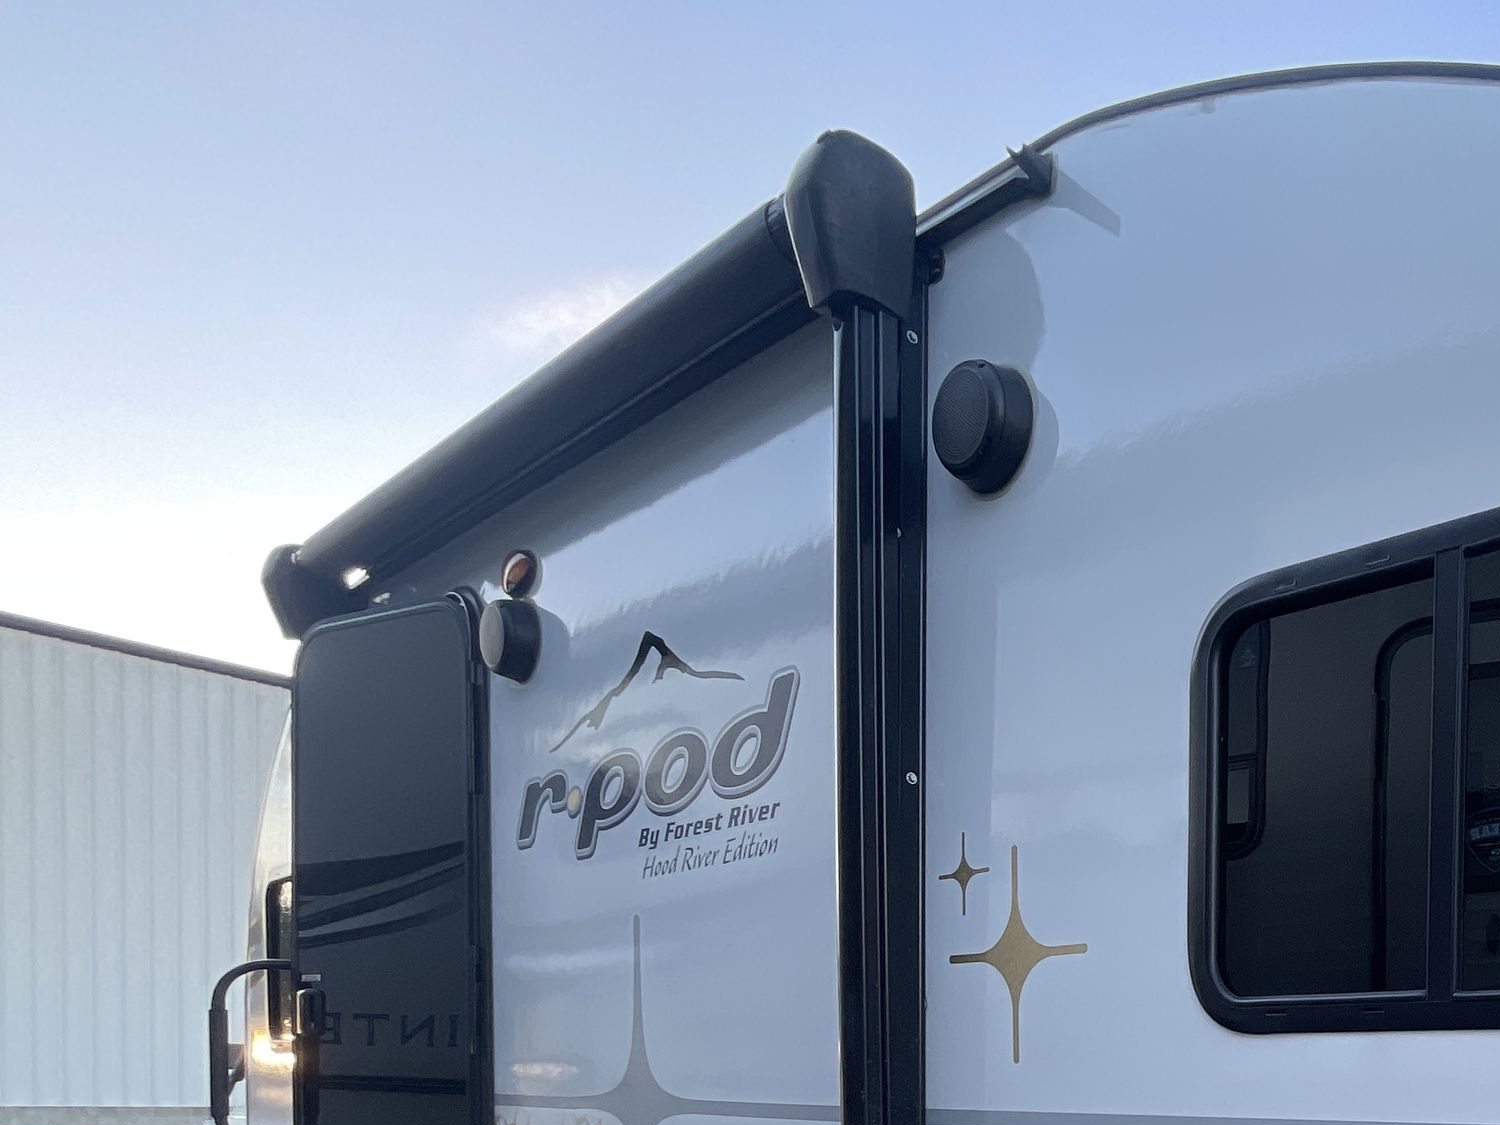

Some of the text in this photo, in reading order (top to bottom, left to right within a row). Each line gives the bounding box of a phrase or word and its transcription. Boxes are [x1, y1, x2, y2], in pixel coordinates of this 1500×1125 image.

[638, 802, 781, 850] By Forest River
[642, 830, 779, 879] Hood River Edition
